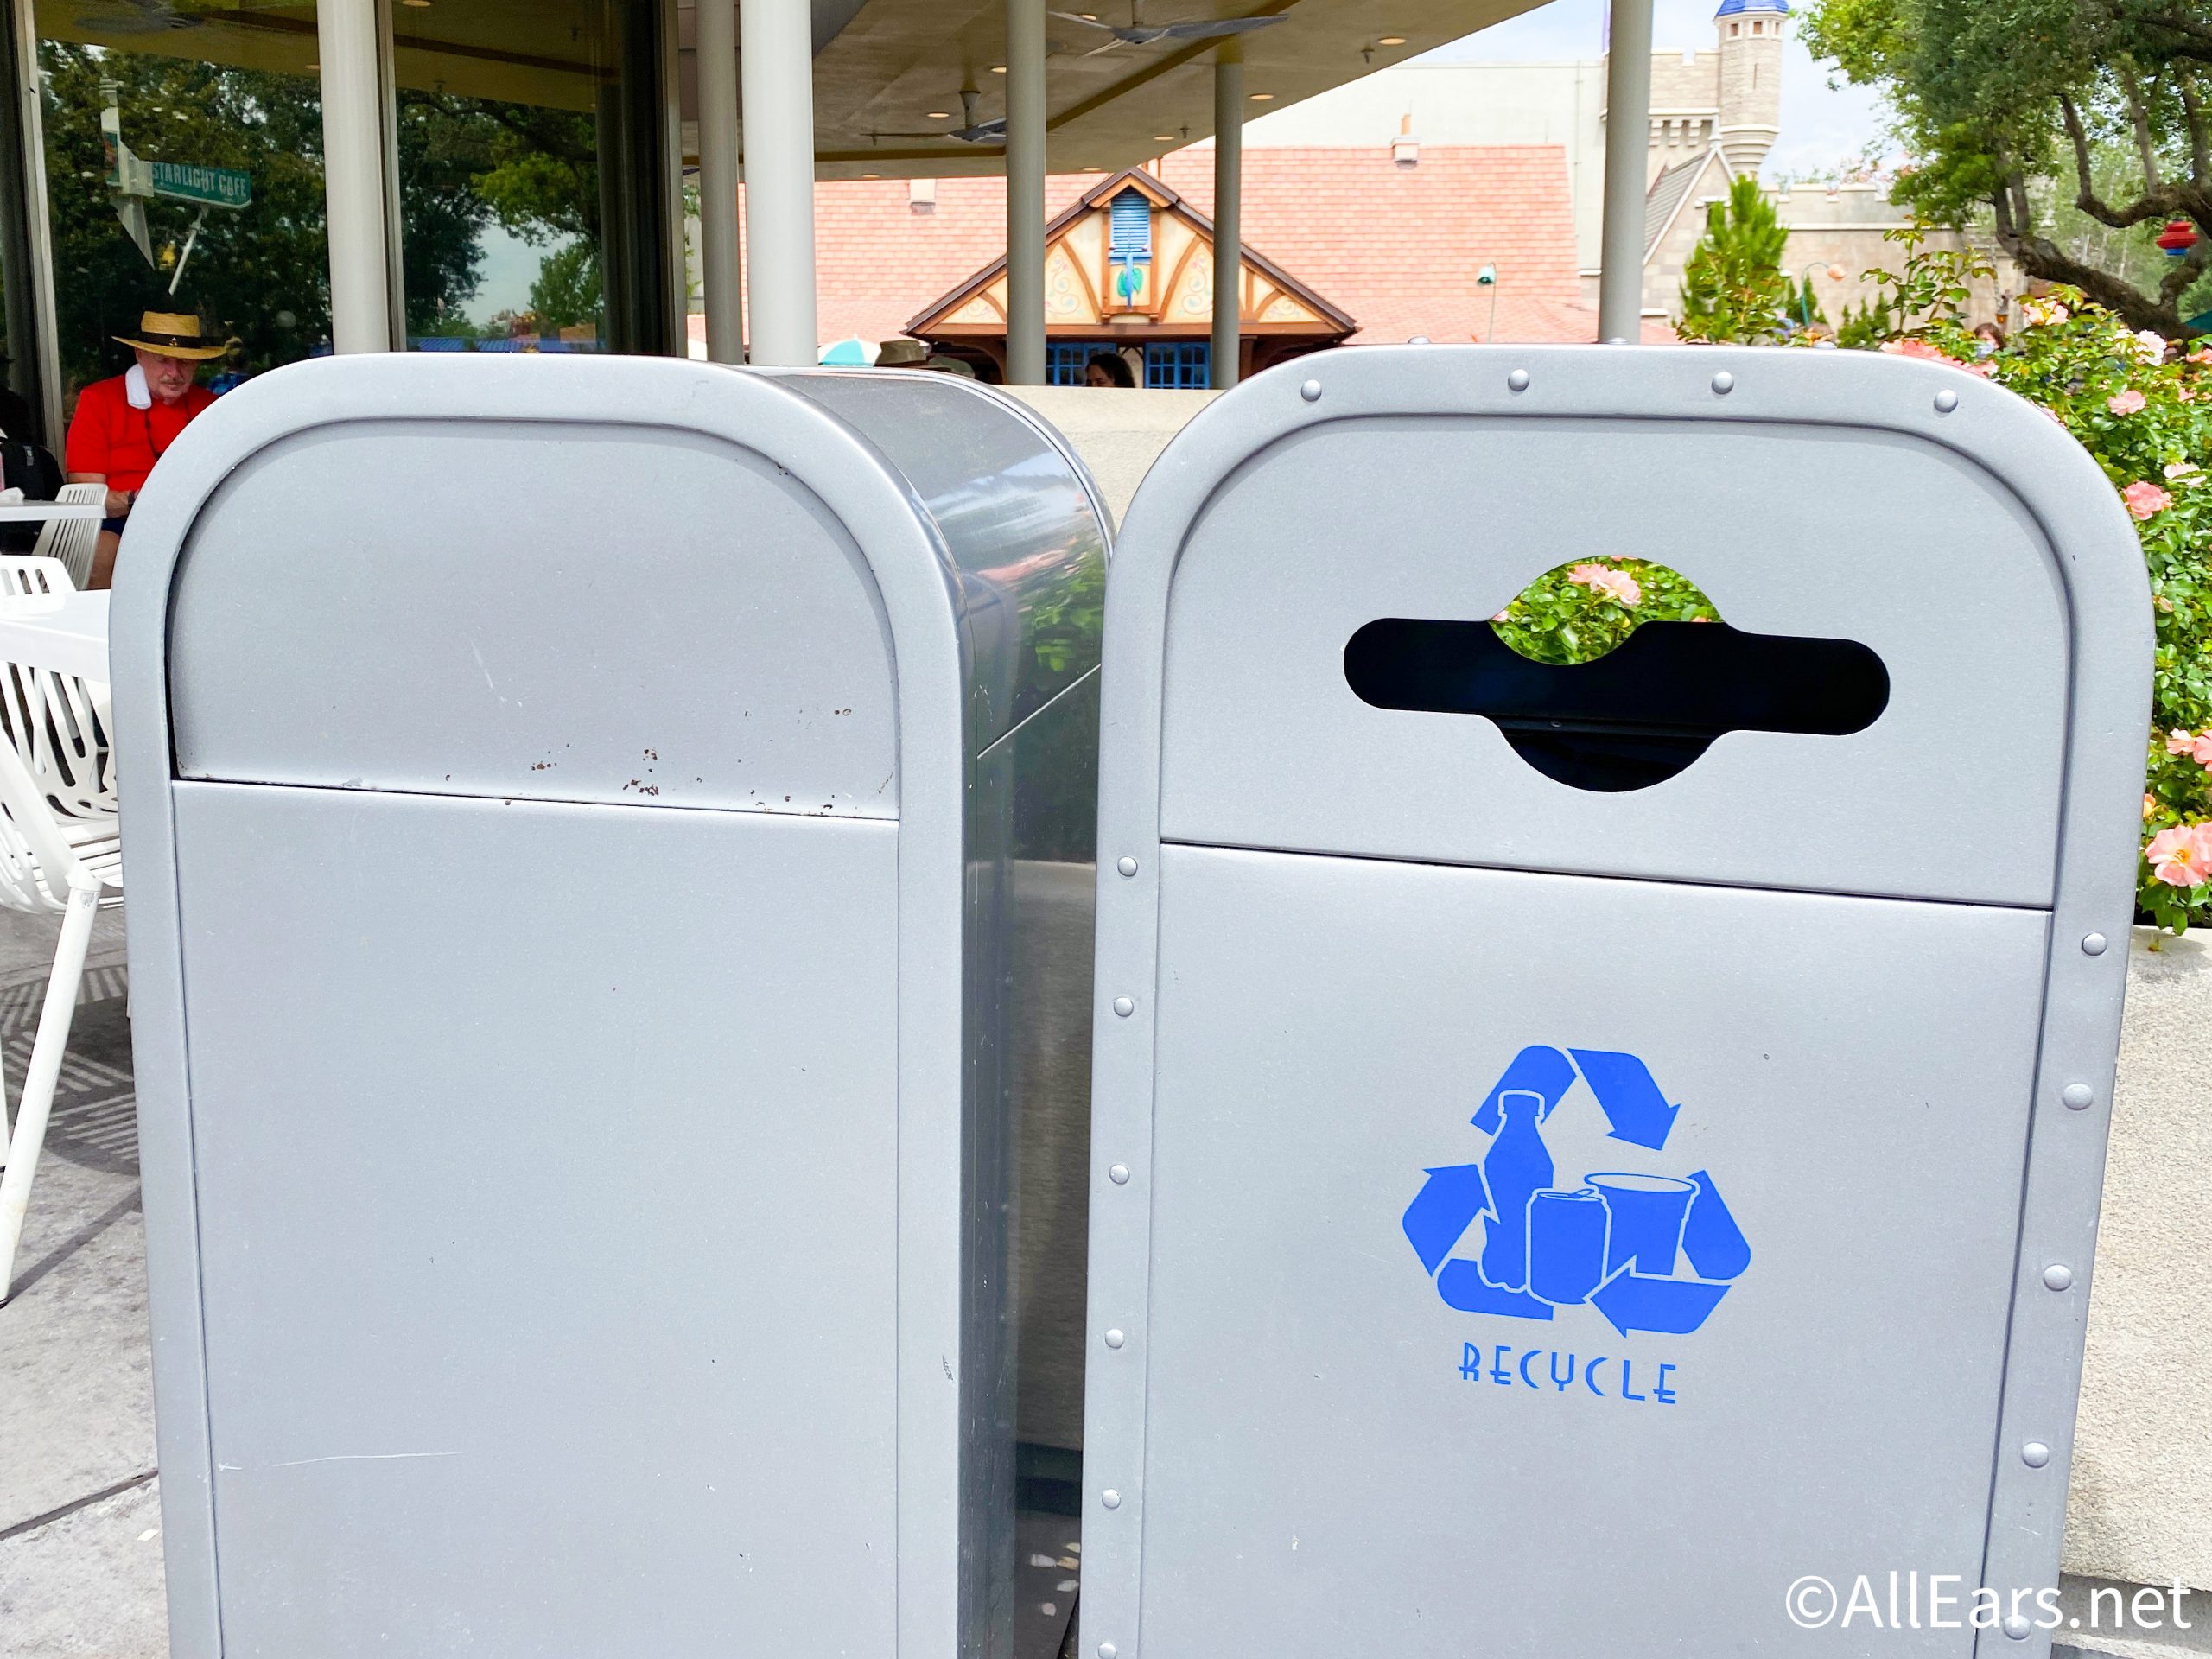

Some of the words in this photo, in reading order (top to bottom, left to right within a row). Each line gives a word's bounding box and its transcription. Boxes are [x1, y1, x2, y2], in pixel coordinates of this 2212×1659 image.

[152, 162, 215, 193] STARLIGHT
[219, 174, 247, 197] CAFE
[1458, 1342, 1677, 1404] RECYCLE
